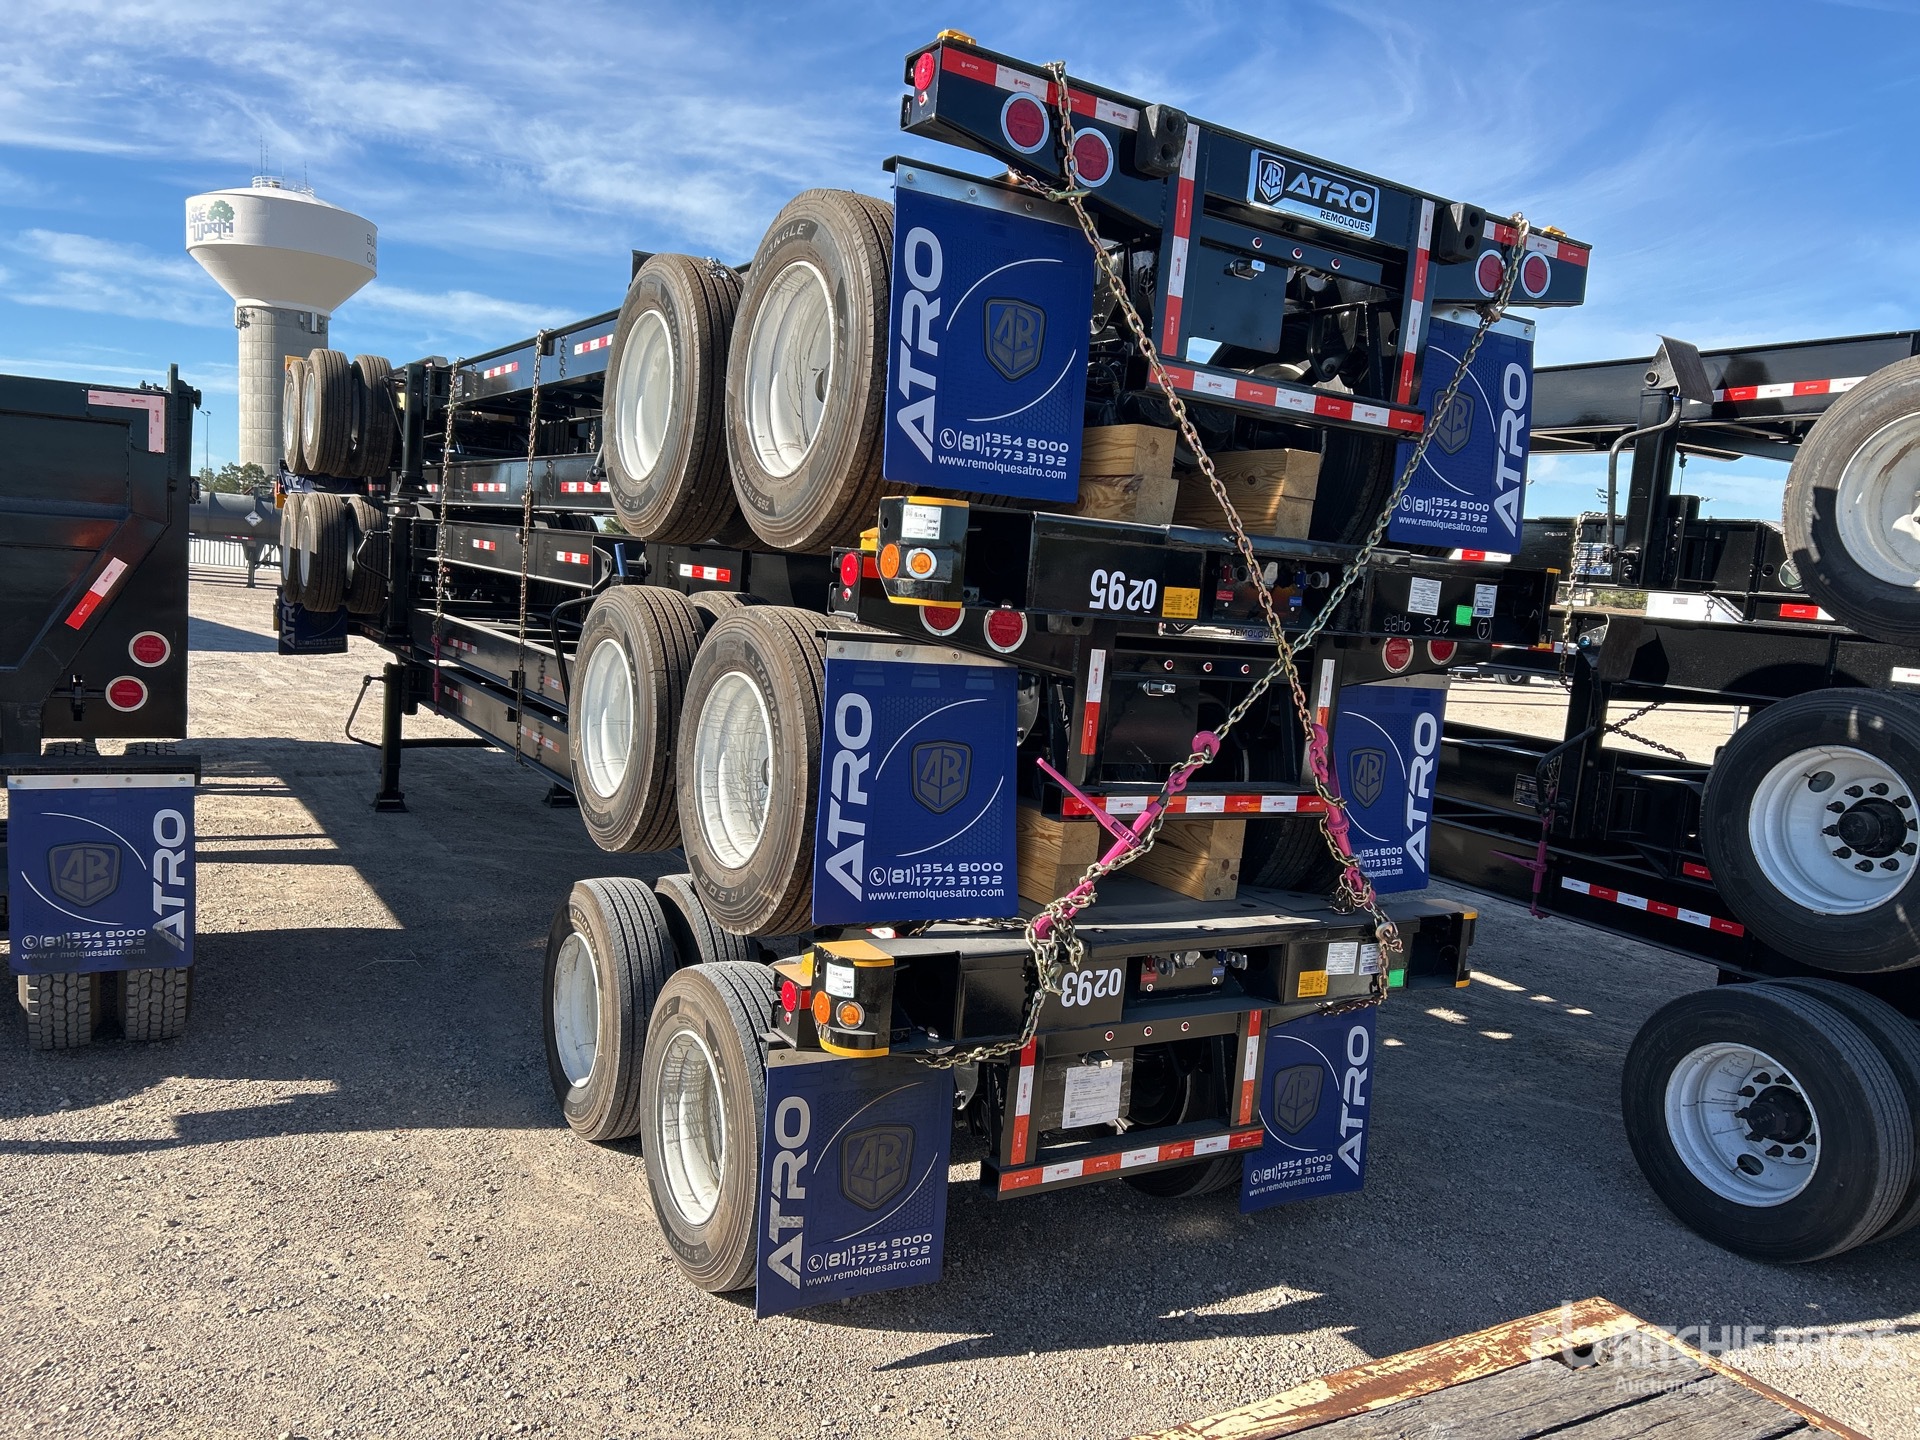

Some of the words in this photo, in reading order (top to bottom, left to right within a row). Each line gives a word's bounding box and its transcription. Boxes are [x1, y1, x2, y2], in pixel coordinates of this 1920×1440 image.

[1286, 172, 1372, 213] ATRO
[189, 222, 234, 242] WORTH
[1320, 209, 1370, 232] REMOLQUES
[897, 226, 943, 463] ATRO
[957, 433, 985, 455] (81)
[985, 431, 1023, 447] 1354
[1026, 437, 1069, 453] 8000
[1494, 362, 1527, 538] ATRO
[938, 454, 1067, 480] www.remolquesatro.com
[984, 447, 1025, 463] 1773
[1027, 451, 1067, 467] 3192
[1412, 496, 1432, 515] (81)
[1431, 497, 1459, 508] 1354
[1460, 500, 1490, 512] 8000
[1431, 508, 1458, 520] 1773
[1460, 511, 1488, 523] 3192
[1399, 515, 1488, 534] www.remolquesatro.com
[1089, 569, 1157, 611] 0295
[1230, 629, 1276, 639] REMOLQUE
[825, 692, 873, 902] ATRO
[1405, 712, 1437, 873] ATRO
[152, 808, 186, 952] ATRO
[887, 866, 915, 886] (81)
[915, 863, 954, 874] 1354
[958, 862, 1003, 872] 8000
[915, 875, 956, 886] 1773
[960, 875, 1002, 885] 3192
[700, 873, 747, 902] TRS02
[868, 887, 1004, 901] www.remolquesatro.com
[39, 934, 66, 950] (81)
[66, 931, 102, 940] 1354
[105, 929, 147, 938] 8000
[66, 940, 103, 949] 1773
[106, 938, 145, 948] 3192
[21, 947, 146, 961] www.rmolquesatro.com
[1061, 968, 1122, 1008] 0293
[1337, 1025, 1369, 1176] ATRO
[1261, 1165, 1278, 1183] (81)
[1278, 1159, 1301, 1171] 1354
[1304, 1153, 1333, 1164] 8000
[1277, 1168, 1302, 1180] 1773
[1305, 1163, 1332, 1174] 3192
[767, 1096, 811, 1290] ATRO
[824, 1249, 850, 1271] (81)
[851, 1240, 887, 1255] 1354
[891, 1233, 933, 1247] 8000
[850, 1252, 889, 1266] 1773
[891, 1245, 930, 1259] 3192
[805, 1256, 931, 1287] www.remolquesatro.com
